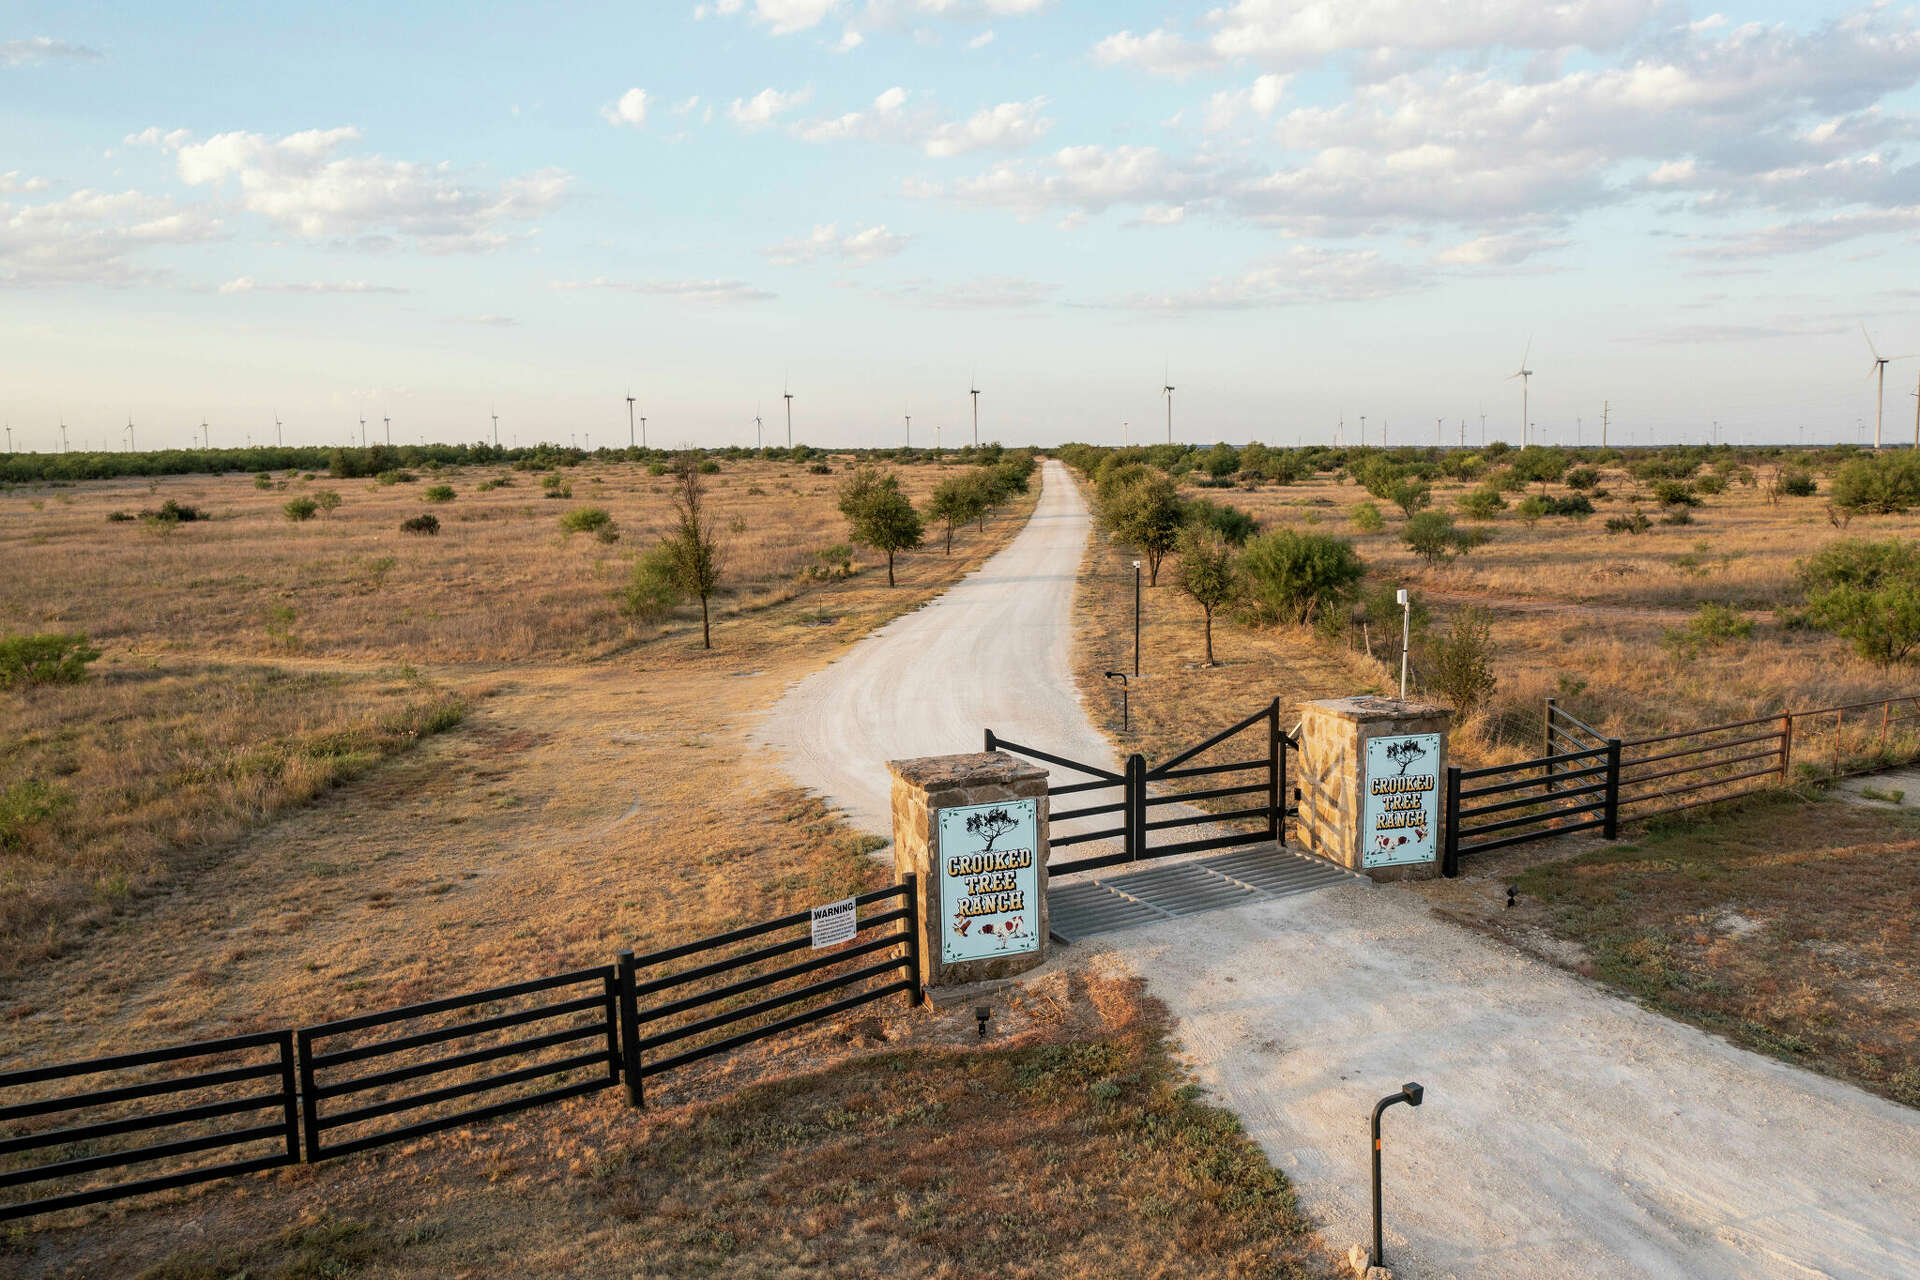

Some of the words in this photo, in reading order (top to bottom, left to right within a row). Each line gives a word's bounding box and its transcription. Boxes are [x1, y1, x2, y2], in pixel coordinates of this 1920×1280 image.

[1371, 774, 1434, 795] CROOKED
[1383, 793, 1422, 811] TREE
[1376, 810, 1426, 830] RANCH
[947, 848, 1032, 877] CROOKED
[965, 871, 1016, 896] TREE
[814, 902, 853, 920] WARNING
[957, 890, 1025, 917] RANCH
